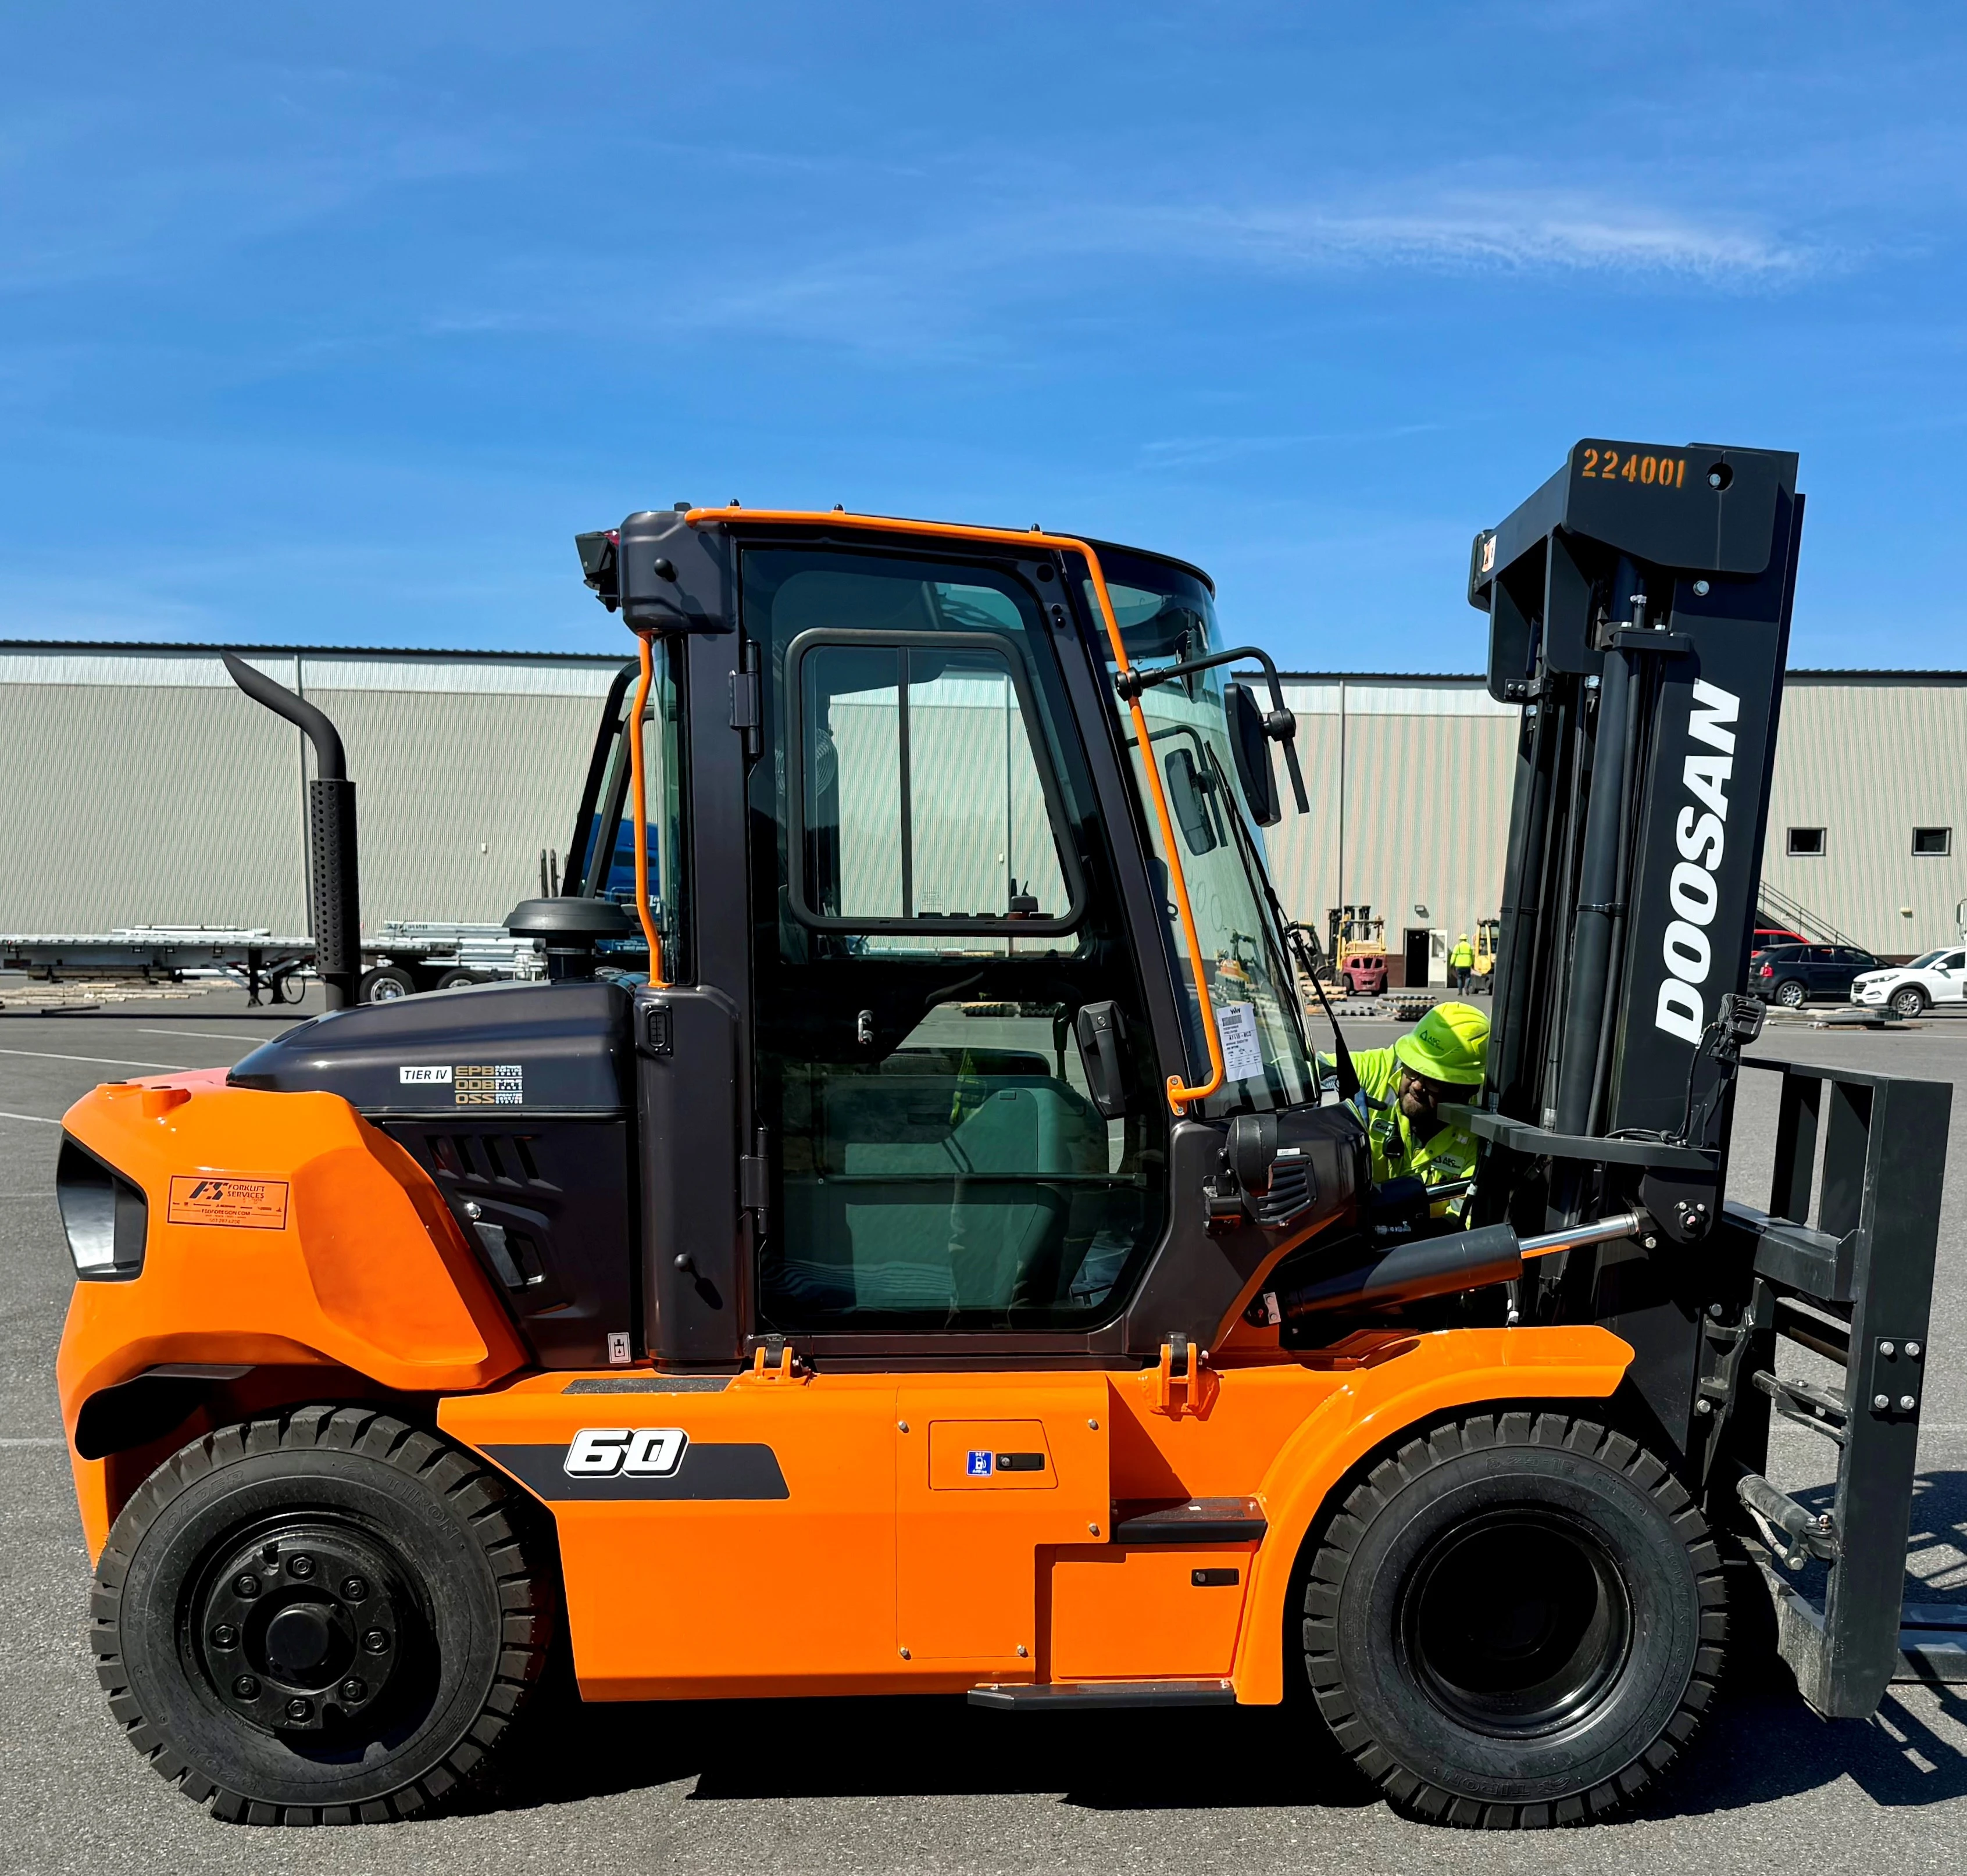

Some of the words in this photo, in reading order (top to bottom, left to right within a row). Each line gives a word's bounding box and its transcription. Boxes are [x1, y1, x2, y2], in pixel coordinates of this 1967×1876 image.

[1582, 448, 1685, 488] 224001
[1655, 678, 1740, 1046] DOOSAN
[405, 1070, 431, 1080] TIER
[436, 1070, 447, 1080] IV
[455, 1066, 494, 1075] EPB
[455, 1080, 494, 1090] ODB
[455, 1094, 495, 1104] OSS
[227, 1184, 265, 1192] FORKLIFT
[563, 1428, 690, 1478] 60
[155, 1469, 244, 1542] LOADER
[1641, 1632, 1690, 1732] LOADER
